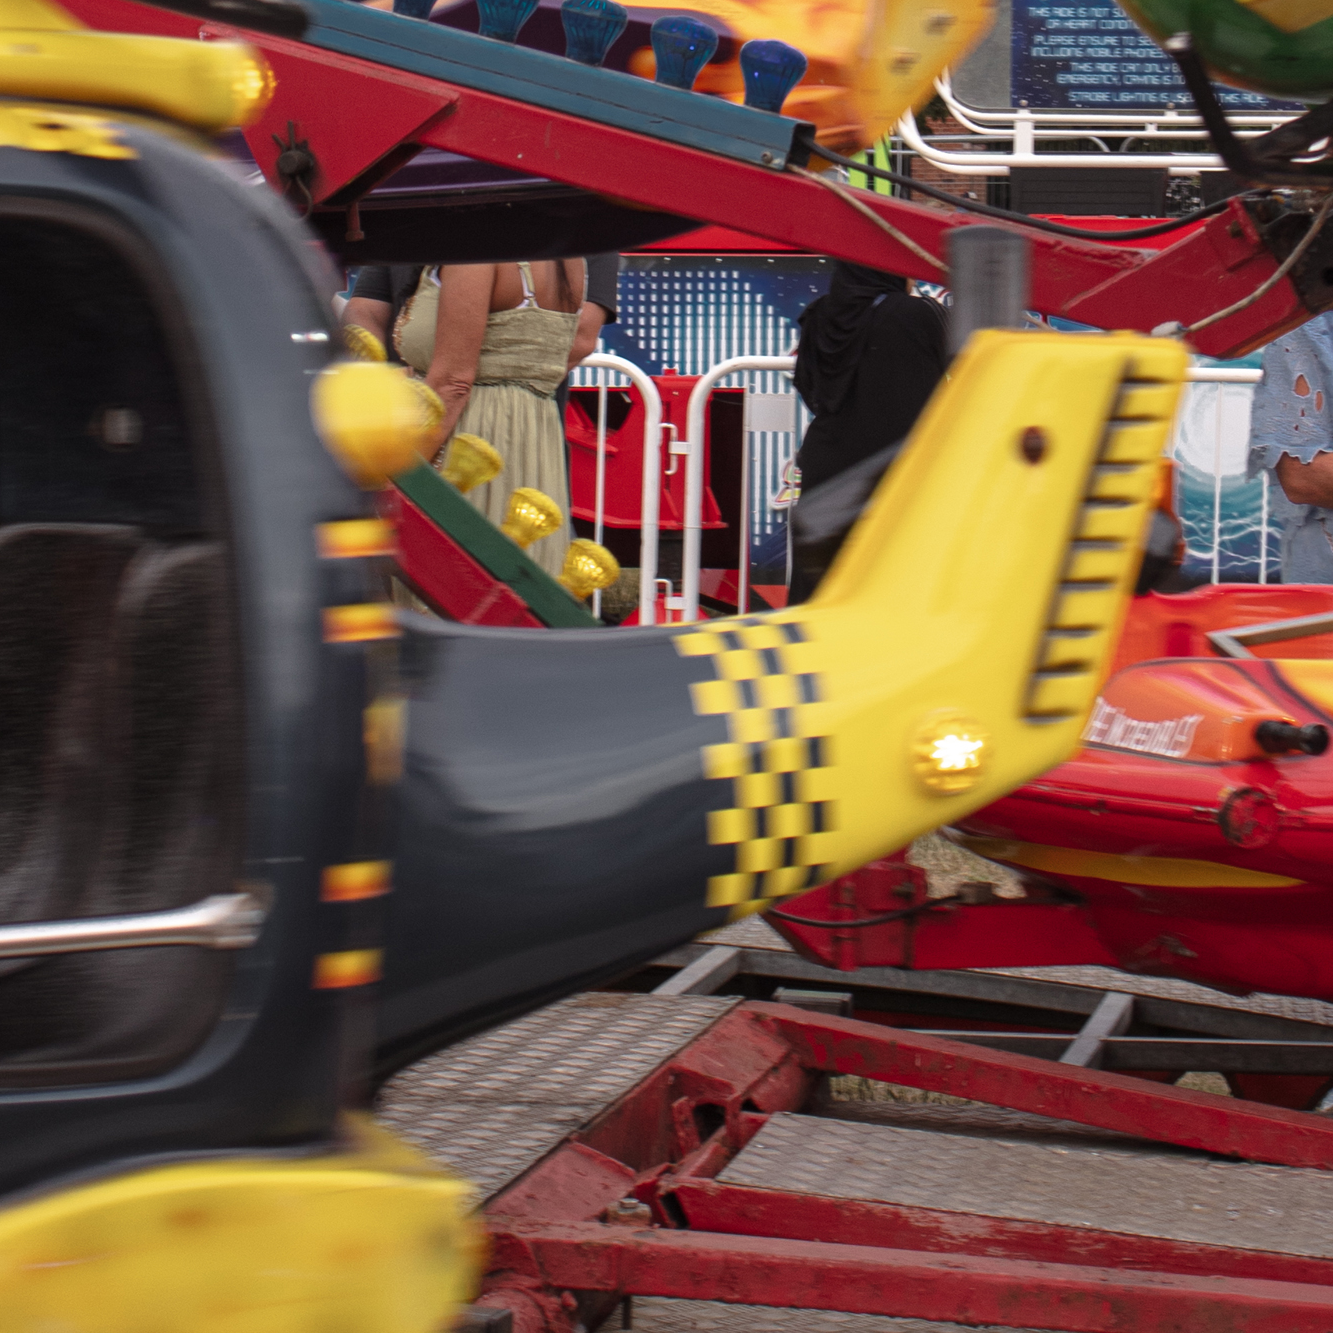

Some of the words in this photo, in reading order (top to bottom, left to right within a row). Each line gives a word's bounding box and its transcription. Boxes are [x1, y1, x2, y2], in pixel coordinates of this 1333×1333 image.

[1027, 7, 1049, 17] THIS
[1051, 7, 1076, 17] RIDE
[1077, 7, 1087, 17] IS
[1089, 7, 1110, 17] NOT
[1063, 19, 1097, 29] HEART
[1032, 36, 1077, 45] PLEASE
[1078, 36, 1120, 45] ENSURE
[1121, 36, 1137, 46] TO
[1030, 47, 1085, 57] INCLUDING
[1085, 47, 1123, 57] MOBILE
[1070, 63, 1095, 73] THIS
[1096, 63, 1119, 73] RIDE
[1121, 63, 1142, 73] CAN
[1143, 63, 1171, 73] ONLY
[1068, 92, 1110, 103] STROBE
[1112, 92, 1158, 103] LIGHTING
[1159, 92, 1169, 103] IS
[1219, 93, 1240, 104] THIS
